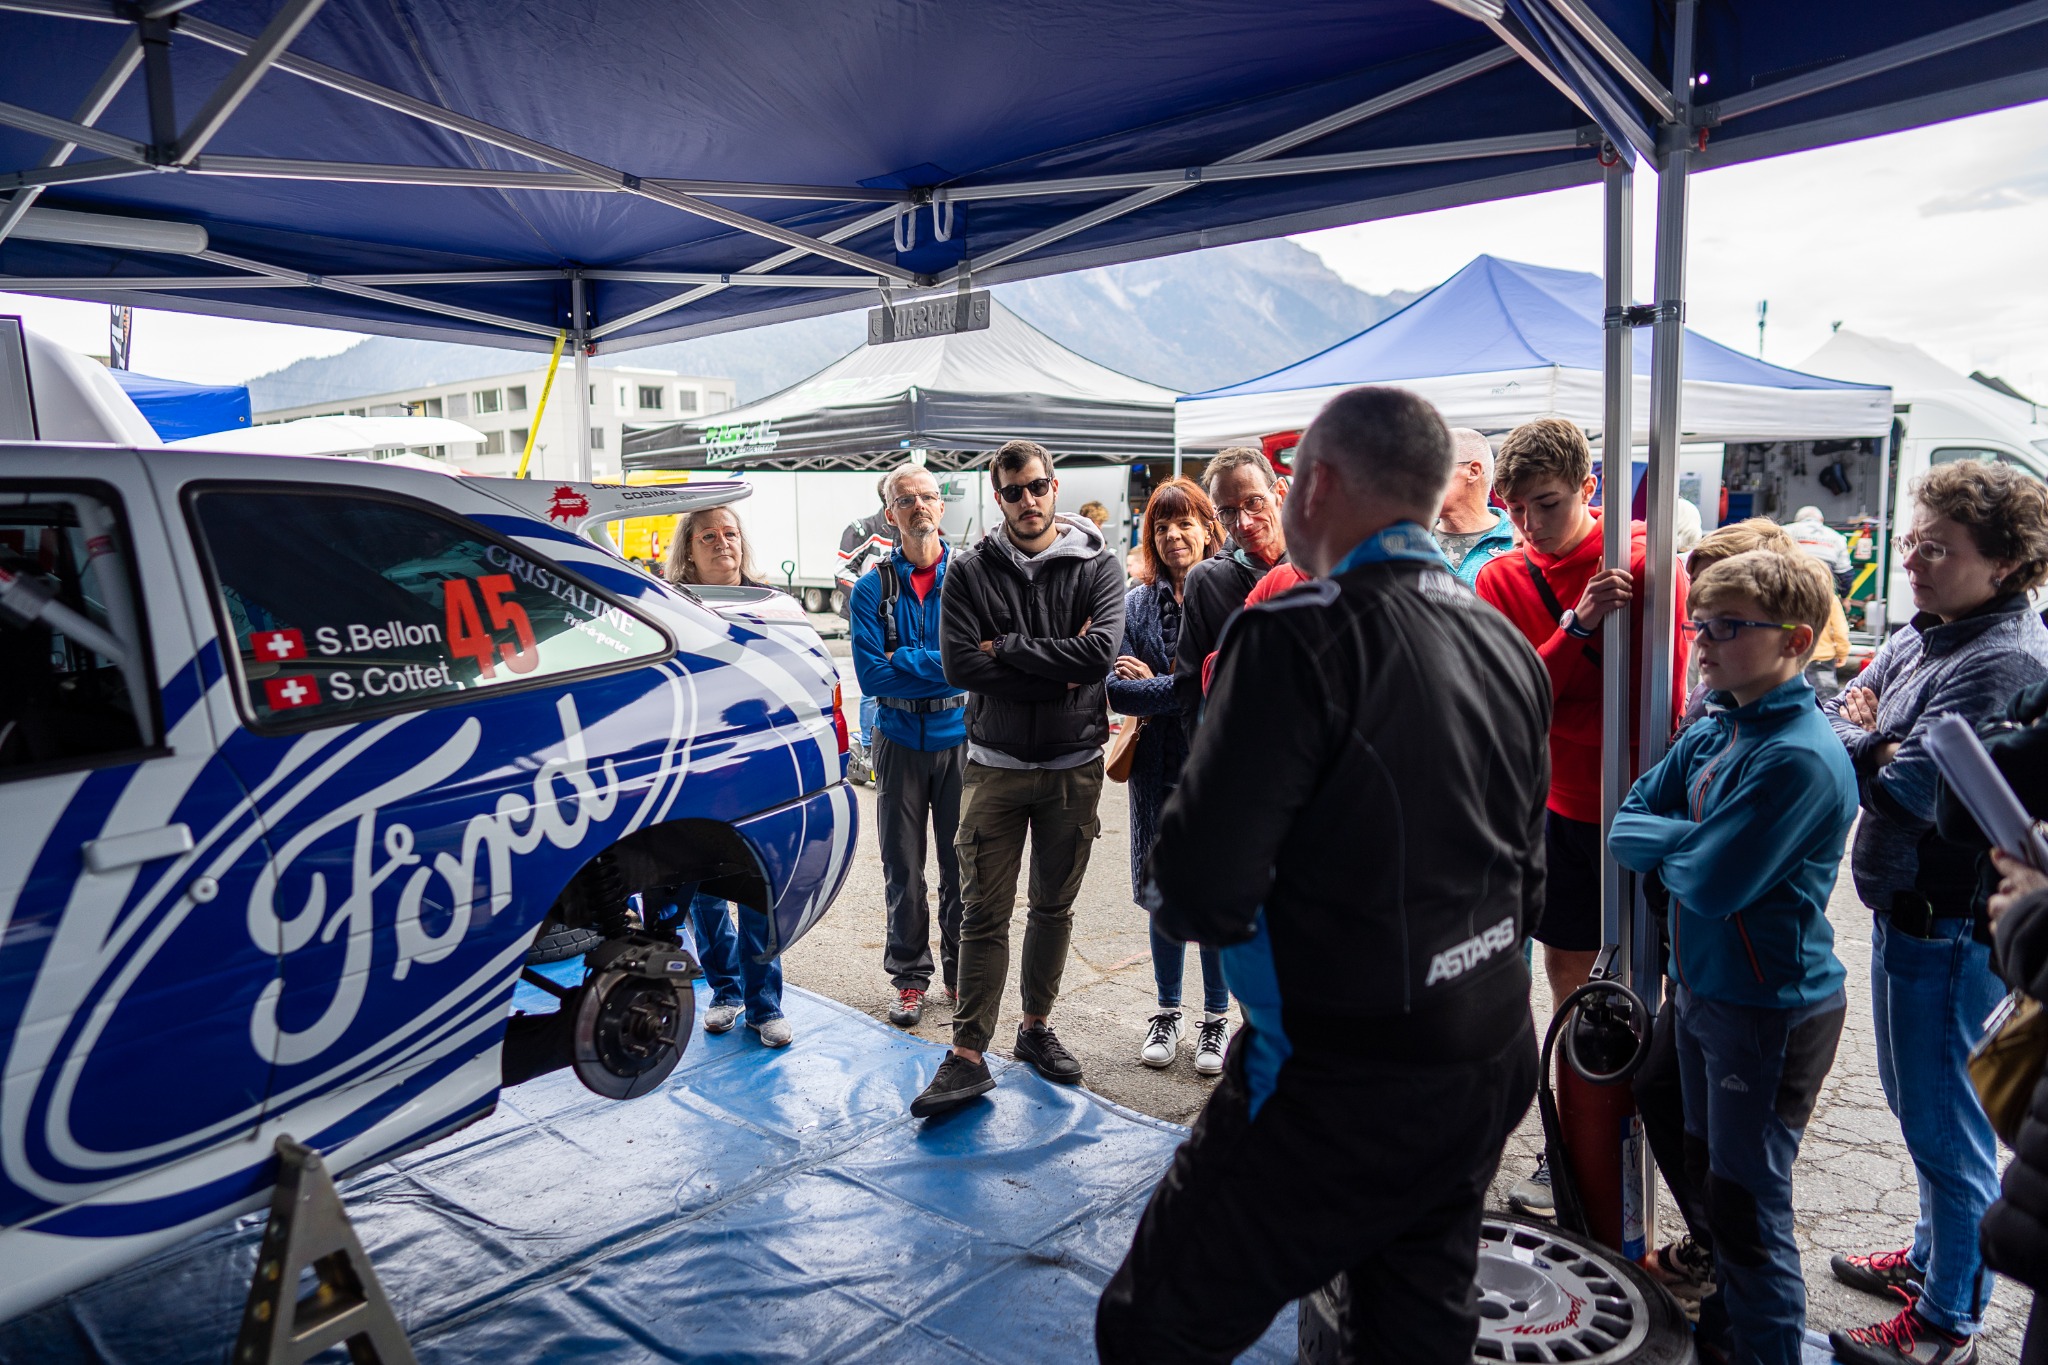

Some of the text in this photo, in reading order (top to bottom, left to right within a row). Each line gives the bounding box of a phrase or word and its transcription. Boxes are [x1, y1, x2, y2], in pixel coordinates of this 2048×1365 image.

[621, 489, 677, 500] COSIMO
[485, 544, 636, 637] CRISTALINE
[315, 620, 442, 655] S.Bellon
[443, 573, 539, 679] 45
[328, 661, 454, 702] S.Cottet
[246, 693, 619, 1065] Ford
[1425, 916, 1514, 986] ASTARS
